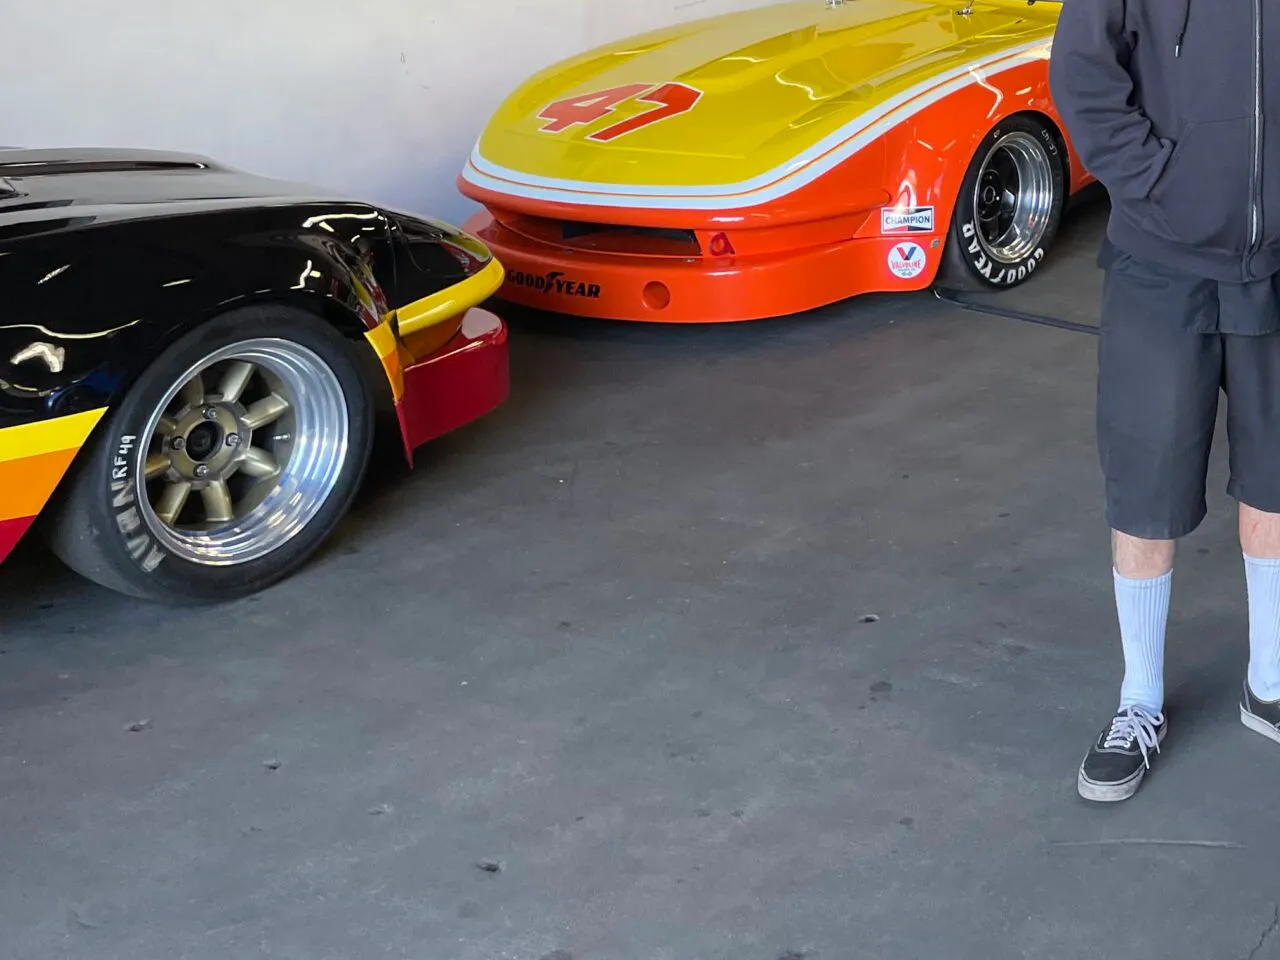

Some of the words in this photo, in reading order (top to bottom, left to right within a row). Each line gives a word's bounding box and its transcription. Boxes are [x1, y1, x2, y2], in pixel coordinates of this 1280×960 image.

[535, 81, 705, 143] 47
[885, 215, 931, 225] CHAMPION
[961, 218, 1045, 284] GOODYEAR
[506, 271, 601, 299] GOODYEAR
